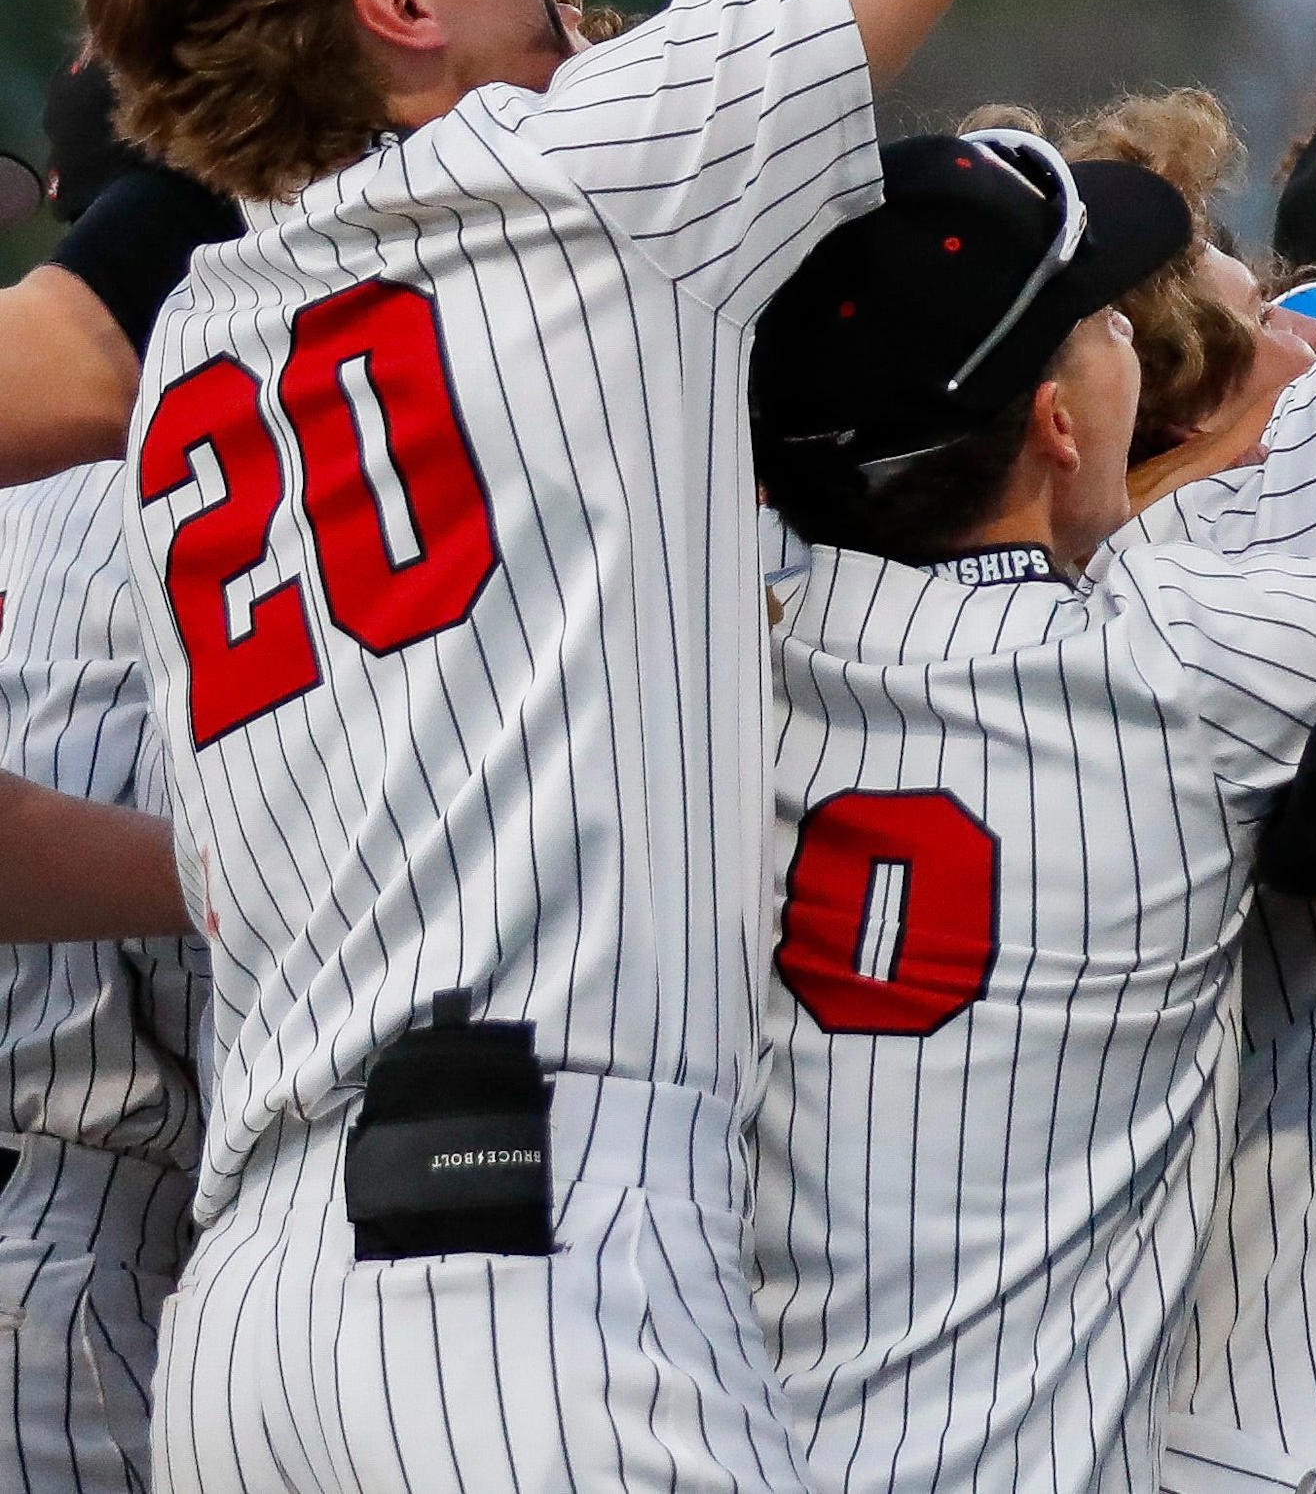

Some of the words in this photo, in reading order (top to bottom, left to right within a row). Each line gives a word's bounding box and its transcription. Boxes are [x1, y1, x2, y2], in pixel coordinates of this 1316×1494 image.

[138, 277, 502, 753] 20
[773, 786, 1002, 1038] 0
[432, 1151, 474, 1169] BOLT
